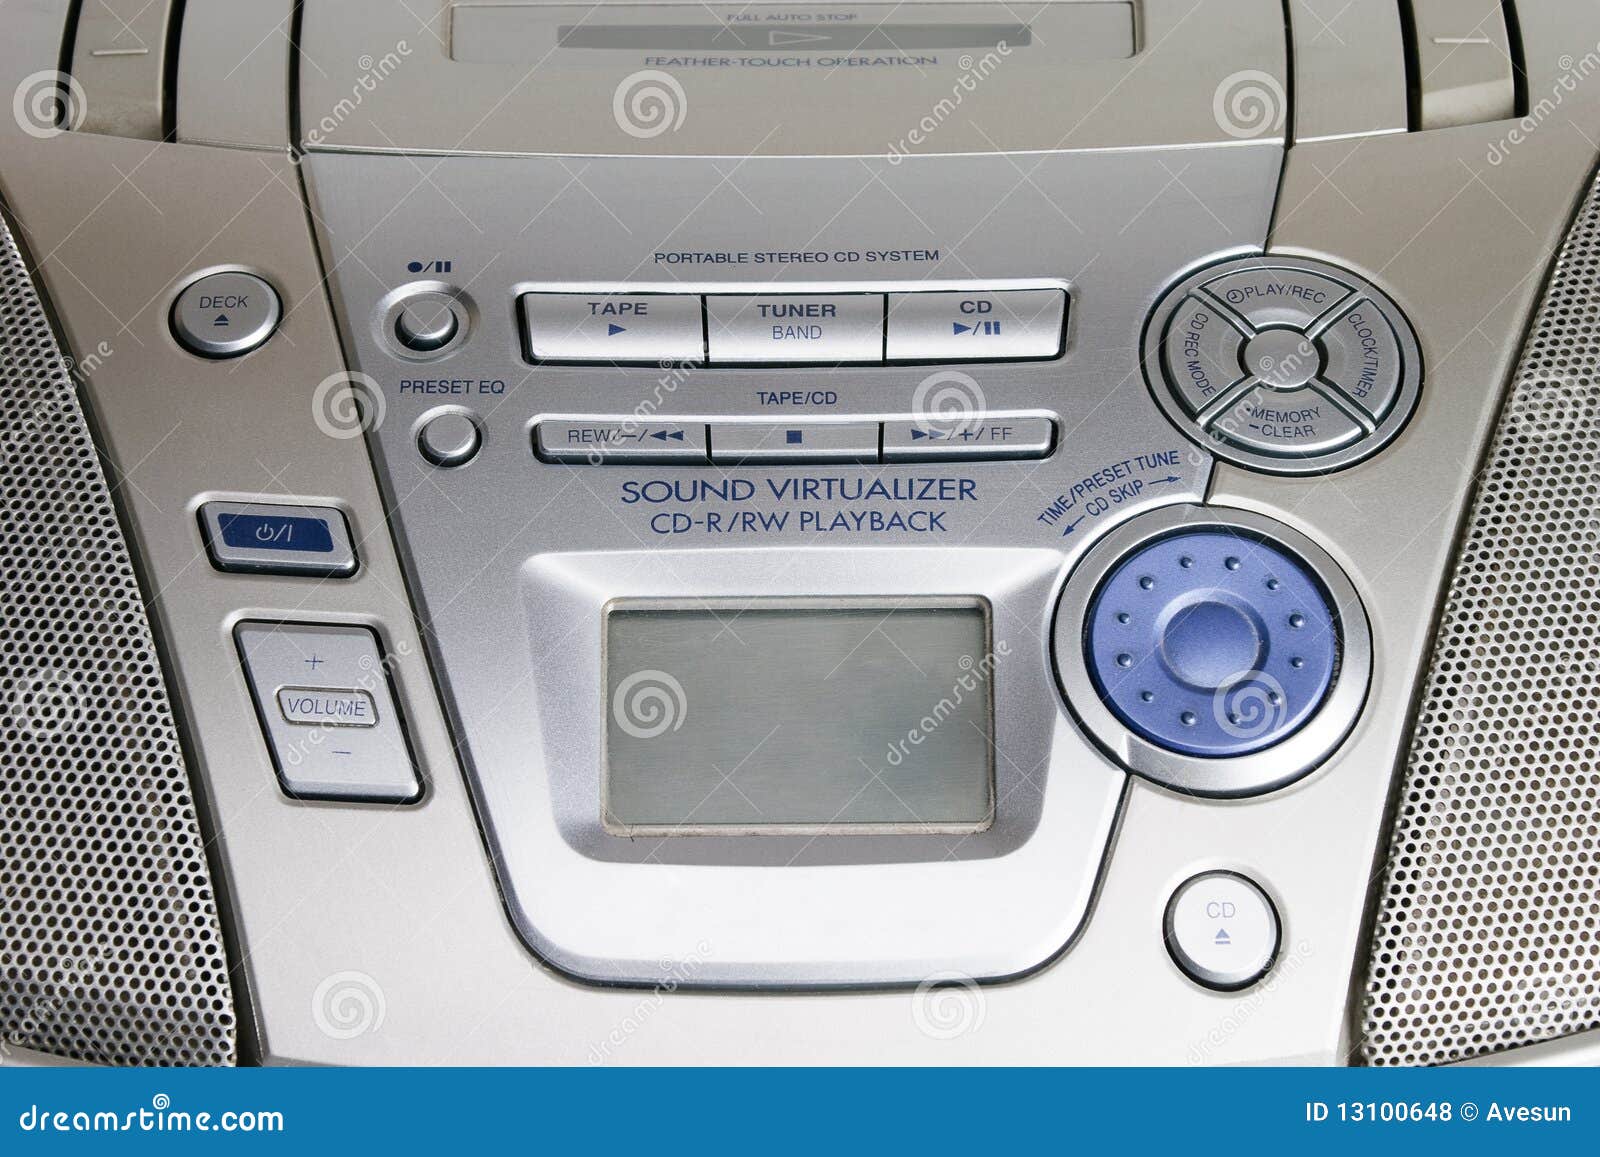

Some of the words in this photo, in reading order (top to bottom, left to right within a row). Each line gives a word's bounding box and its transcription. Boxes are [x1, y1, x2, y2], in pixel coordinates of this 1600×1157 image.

[727, 13, 759, 22] FULL
[765, 13, 812, 22] AUTO
[816, 13, 857, 22] STOP
[644, 55, 810, 68] FEATHER-TOUCH
[816, 55, 938, 67] OPERATION
[654, 252, 749, 264] PORTABLE
[754, 251, 829, 264] STEREO
[833, 251, 860, 263] CD
[866, 249, 939, 262] SYSTEM
[199, 294, 249, 309] DECK
[587, 301, 648, 316] TAPE
[959, 299, 993, 315] CD
[757, 303, 837, 318] TUNER
[1189, 311, 1209, 330] CD
[771, 324, 823, 340] BAND
[1184, 330, 1201, 358] REC
[1347, 312, 1379, 399] CLOCK/TIMER
[400, 379, 474, 395] PRESET
[478, 379, 506, 396] EQ
[1186, 360, 1217, 398] MODE
[757, 390, 838, 406] TAPE/CD
[991, 427, 1013, 441] FF
[621, 478, 756, 504] SOUND
[766, 477, 979, 502] VIRTUALIZER
[1037, 460, 1133, 526] TIME/PRESET
[1134, 450, 1181, 471] TUNE
[1085, 496, 1110, 517] CD
[1108, 479, 1144, 503] SKIP
[650, 511, 790, 536] CD-R/RW
[800, 509, 948, 533] PLAYBACK
[287, 697, 367, 717] VOLUME
[1206, 901, 1236, 919] CD
